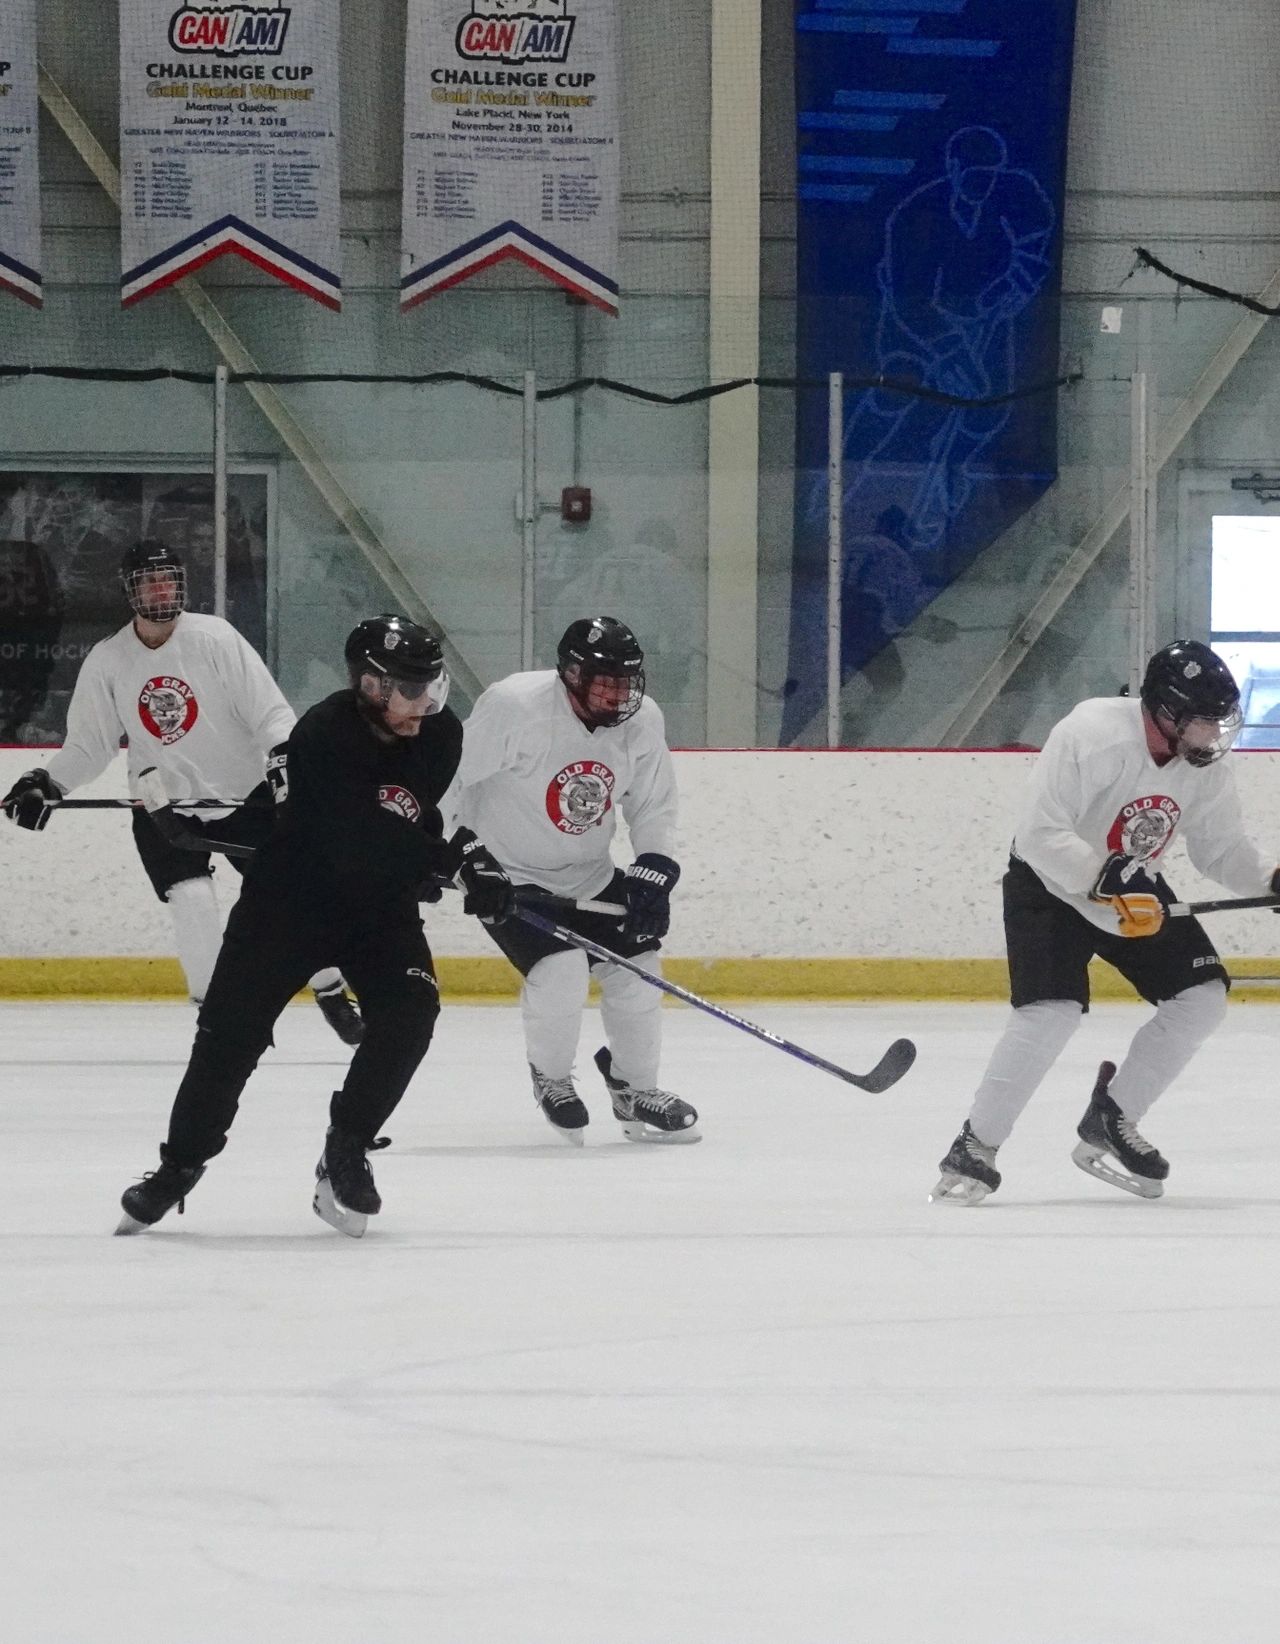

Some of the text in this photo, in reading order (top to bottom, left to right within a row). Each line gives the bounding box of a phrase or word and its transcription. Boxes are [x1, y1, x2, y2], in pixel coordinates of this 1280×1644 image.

[146, 64, 314, 80] CHALLENGE CUP
[431, 69, 596, 87] CHALLENGE CUP
[147, 81, 315, 101] Gold Medal Winner
[431, 86, 597, 107] Gold Medal Winner
[172, 116, 213, 127] January
[216, 116, 229, 126] 12
[259, 117, 287, 127] 2018
[456, 108, 479, 118] Lake
[518, 110, 542, 119] New
[545, 110, 570, 120] York
[451, 120, 505, 131] November
[546, 123, 573, 133] 2014
[35, 643, 92, 660] HOCK
[162, 678, 193, 699] GRAY
[557, 764, 584, 784] OLD
[1123, 798, 1180, 822] OLD GRA
[557, 818, 590, 834] PUC
[626, 865, 668, 887] RIOR
